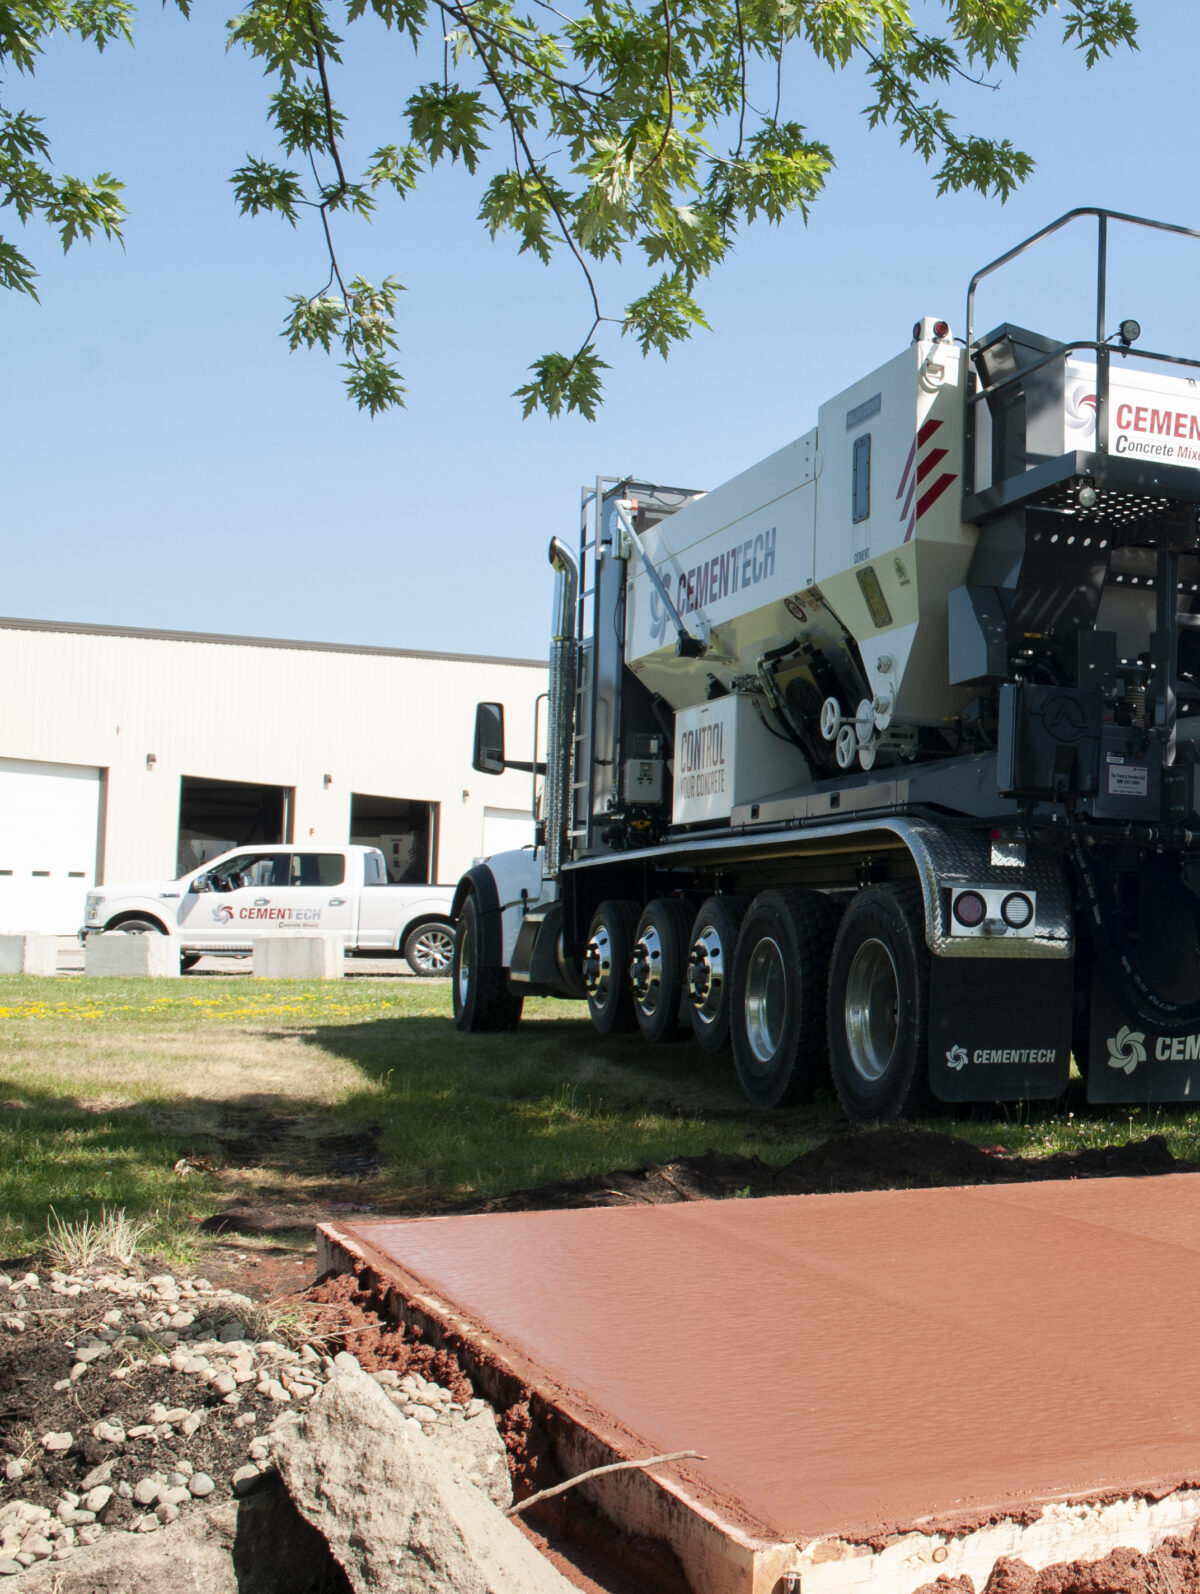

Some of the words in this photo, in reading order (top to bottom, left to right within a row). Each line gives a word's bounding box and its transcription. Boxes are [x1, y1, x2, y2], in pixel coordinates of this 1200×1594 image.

[1115, 435, 1174, 457] Concrete
[677, 527, 777, 619] CEMENTECH
[681, 721, 725, 773] CONTROL
[239, 907, 321, 920] CEMENTECH
[973, 1049, 1056, 1064] CEMENTECH
